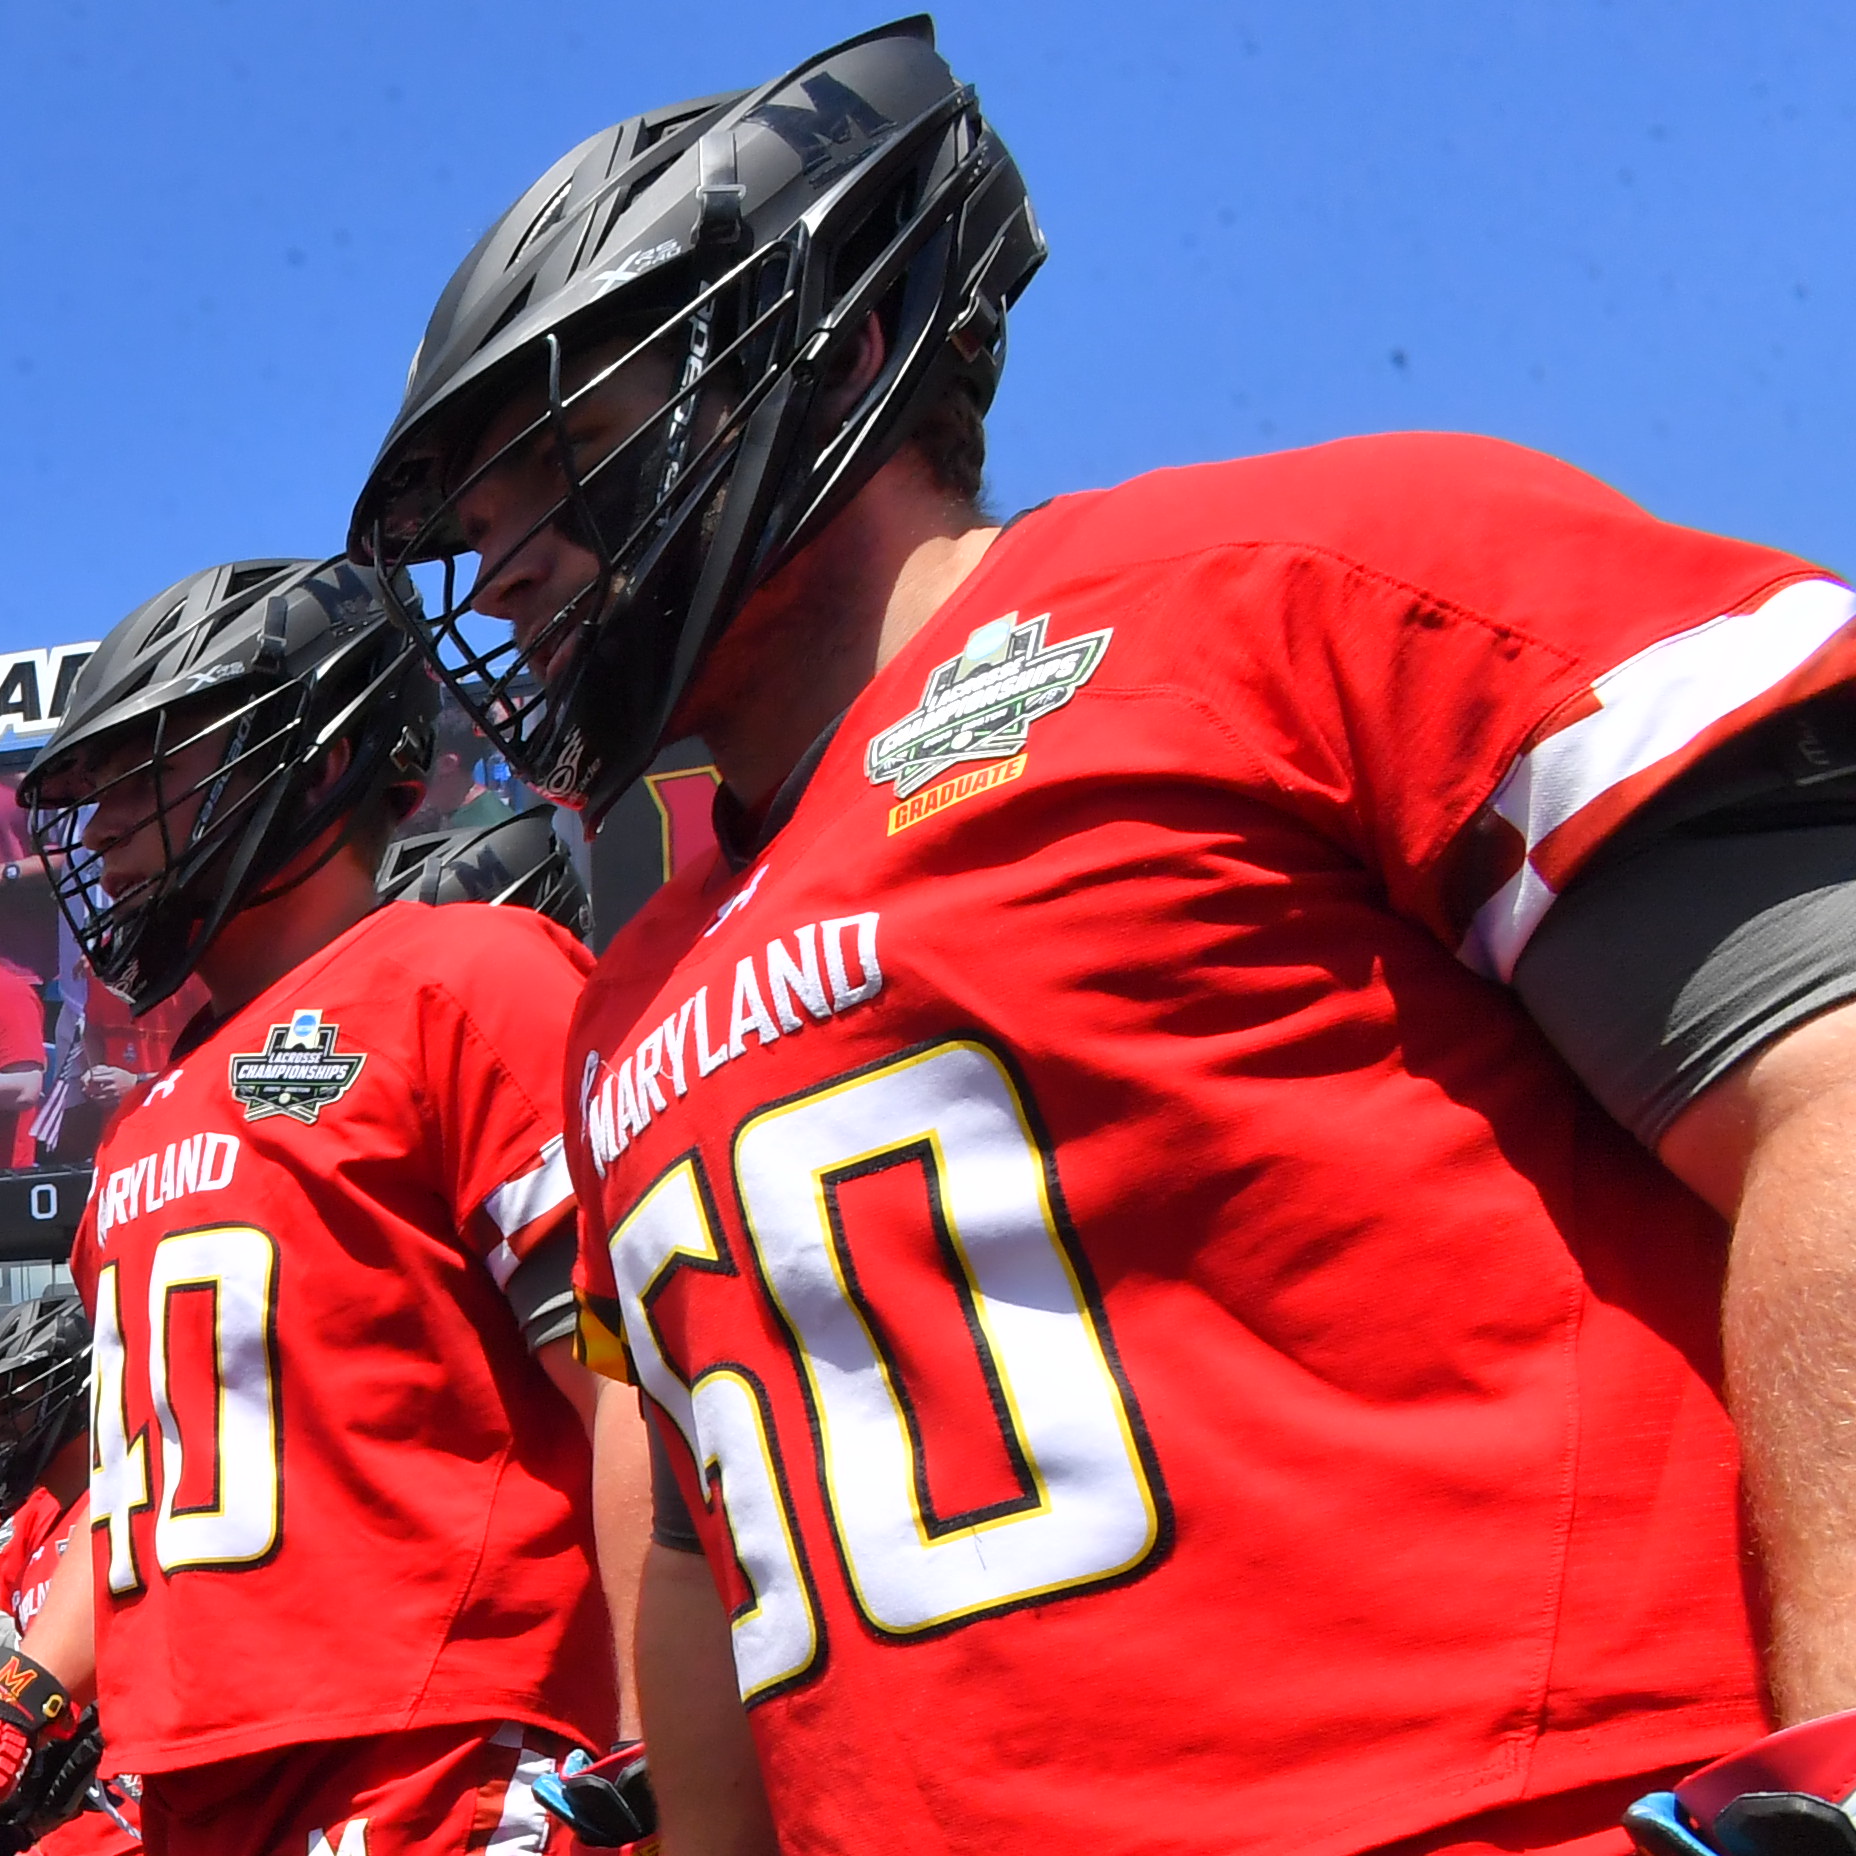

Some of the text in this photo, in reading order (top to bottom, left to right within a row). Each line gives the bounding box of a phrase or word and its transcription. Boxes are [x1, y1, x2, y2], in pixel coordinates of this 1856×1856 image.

[893, 757, 1024, 831] GRADUATE
[238, 1064, 349, 1080] CHAMPIONSHIPS
[268, 1052, 323, 1064] LACROSSE
[588, 911, 884, 1181] MARYLAND
[30, 1183, 58, 1221] 0
[97, 1132, 241, 1251] RYLAND
[88, 1222, 280, 1596] 40
[608, 1037, 1172, 1708] 50
